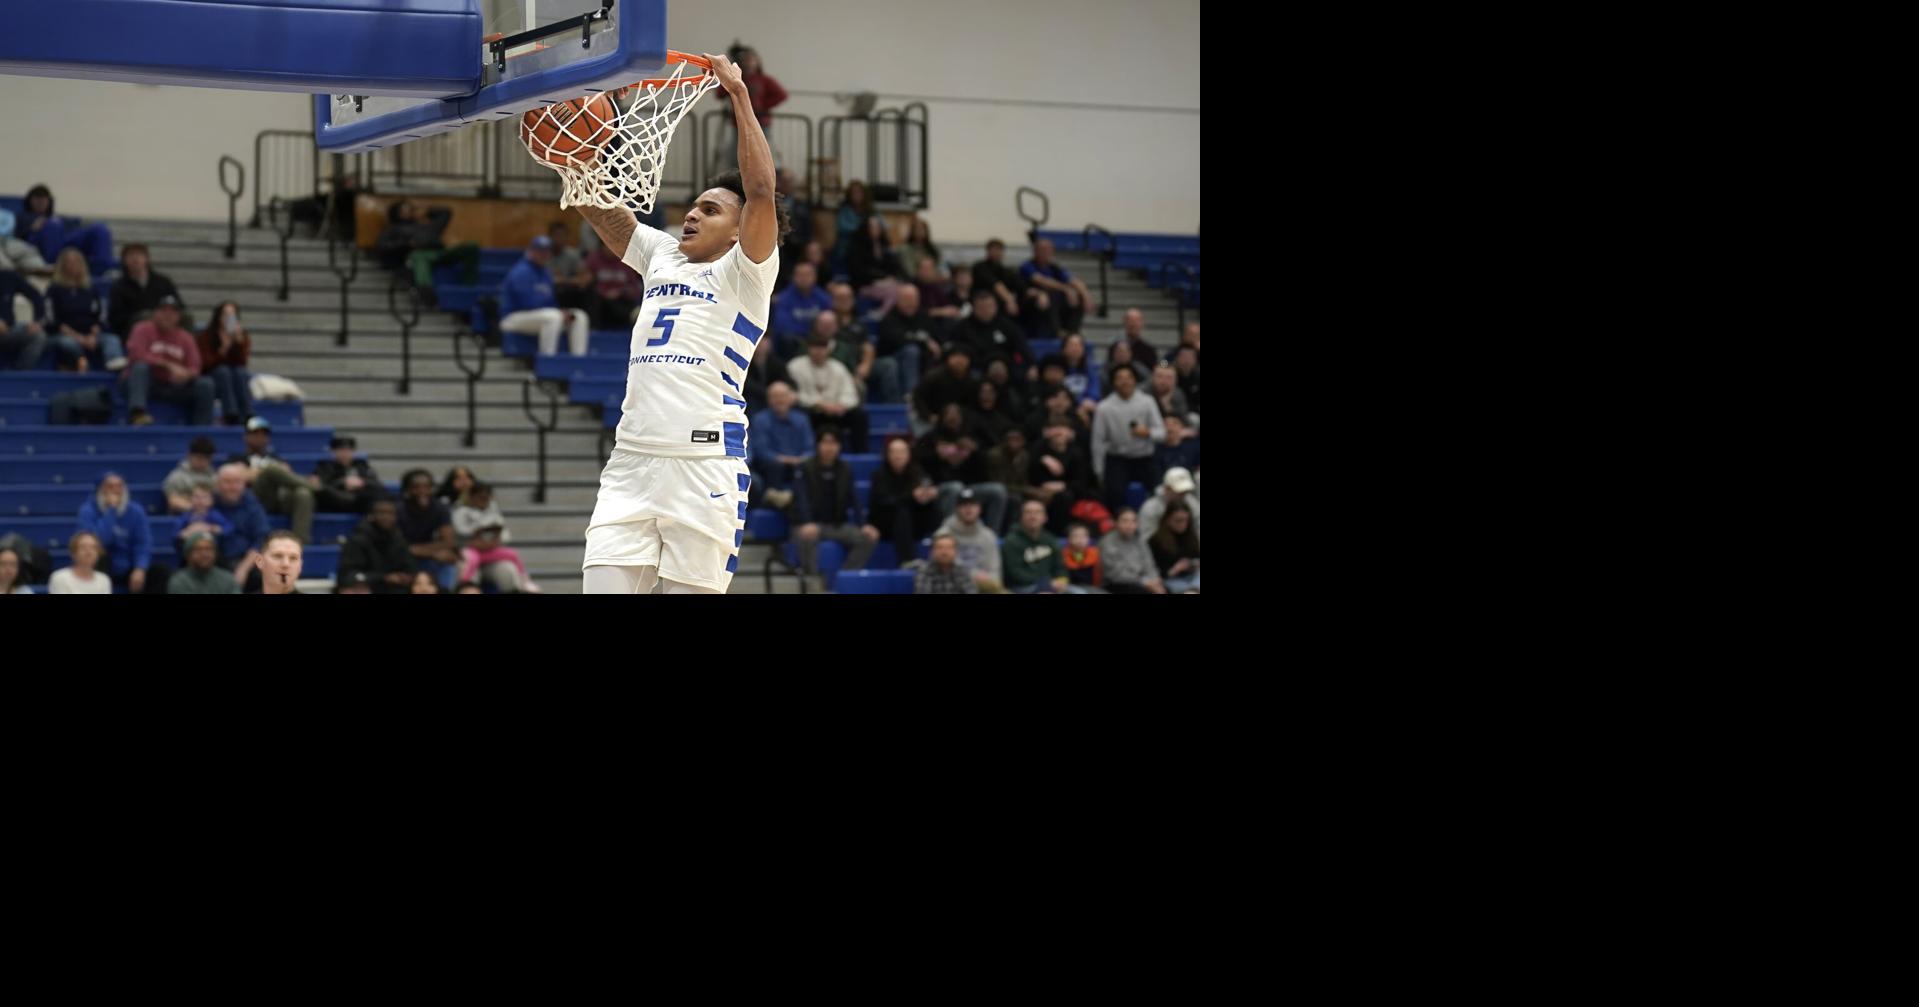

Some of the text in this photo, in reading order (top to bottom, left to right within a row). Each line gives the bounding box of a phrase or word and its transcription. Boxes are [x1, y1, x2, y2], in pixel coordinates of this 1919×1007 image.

[645, 283, 718, 304] ENTRAL
[646, 308, 681, 347] 5
[629, 355, 706, 366] ONNECTICUT
